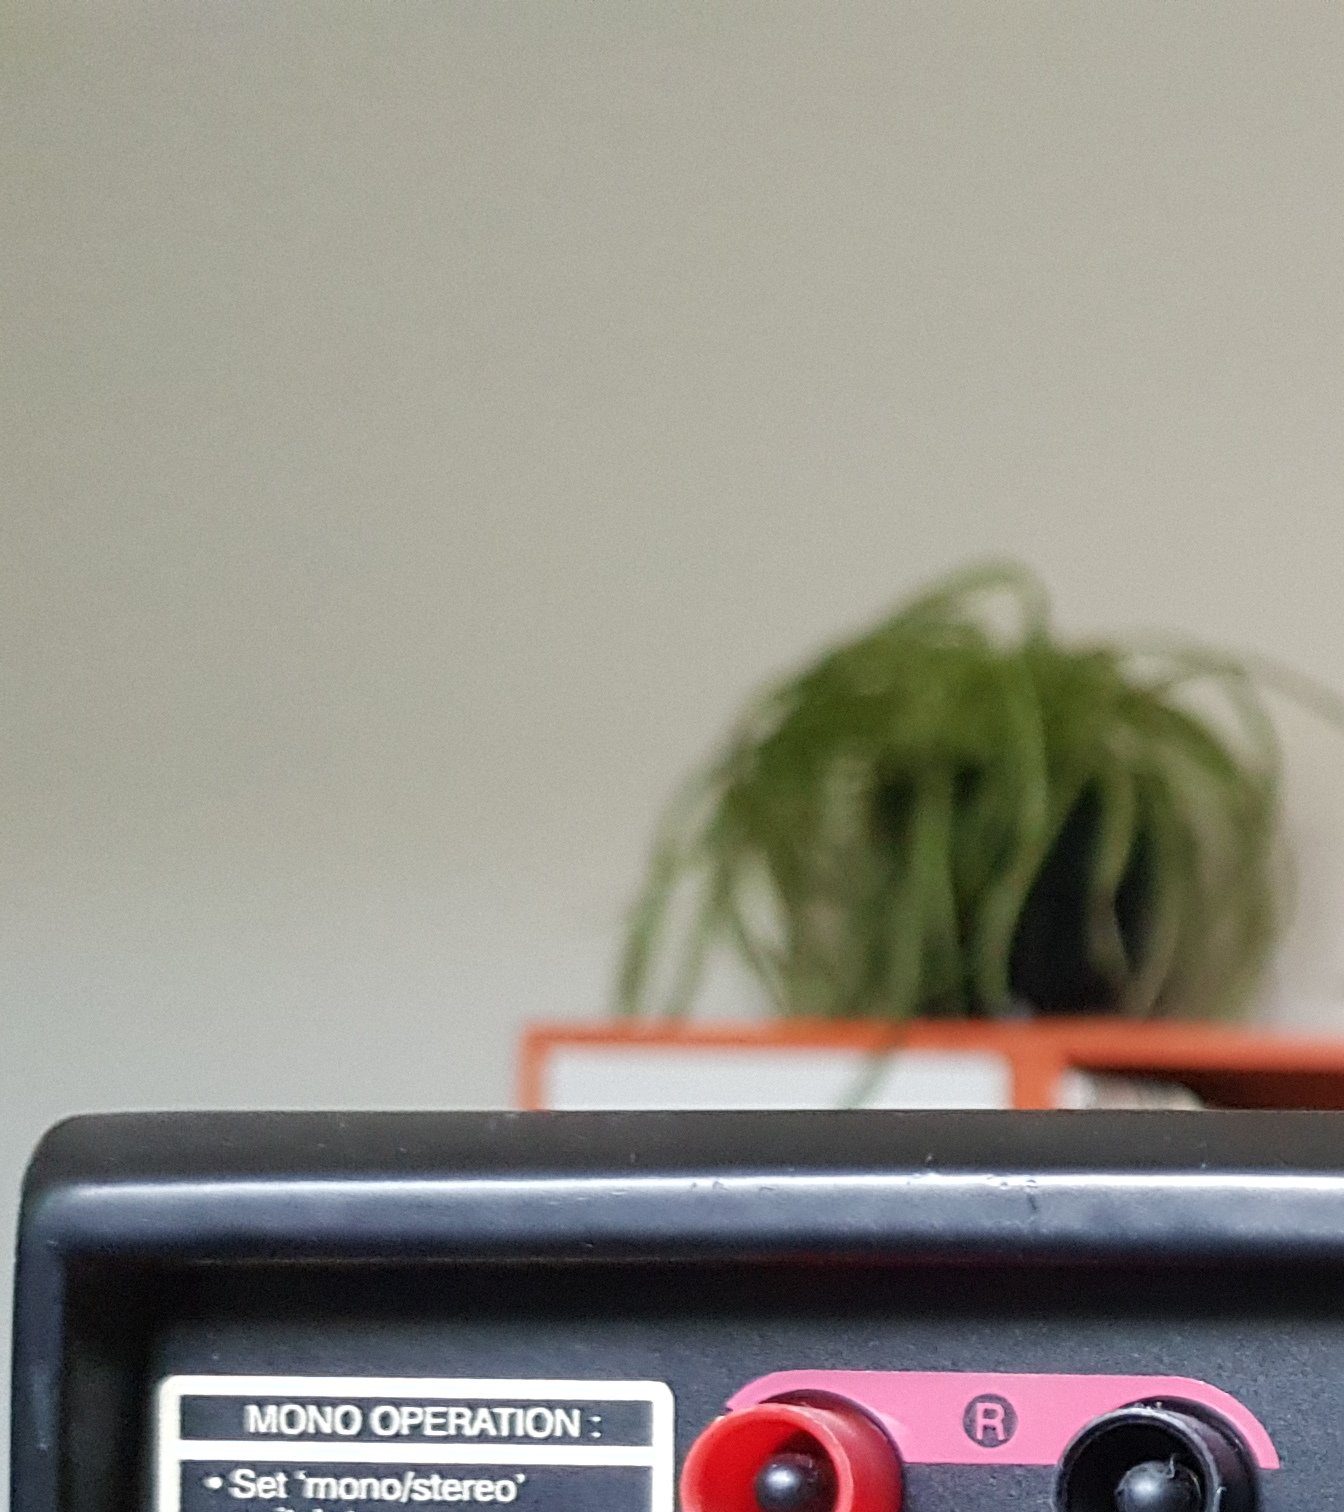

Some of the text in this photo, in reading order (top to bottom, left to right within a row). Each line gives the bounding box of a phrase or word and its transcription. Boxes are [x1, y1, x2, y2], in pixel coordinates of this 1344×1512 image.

[246, 1404, 362, 1435] MONO
[975, 1401, 1004, 1440] R
[229, 1470, 287, 1499] Set
